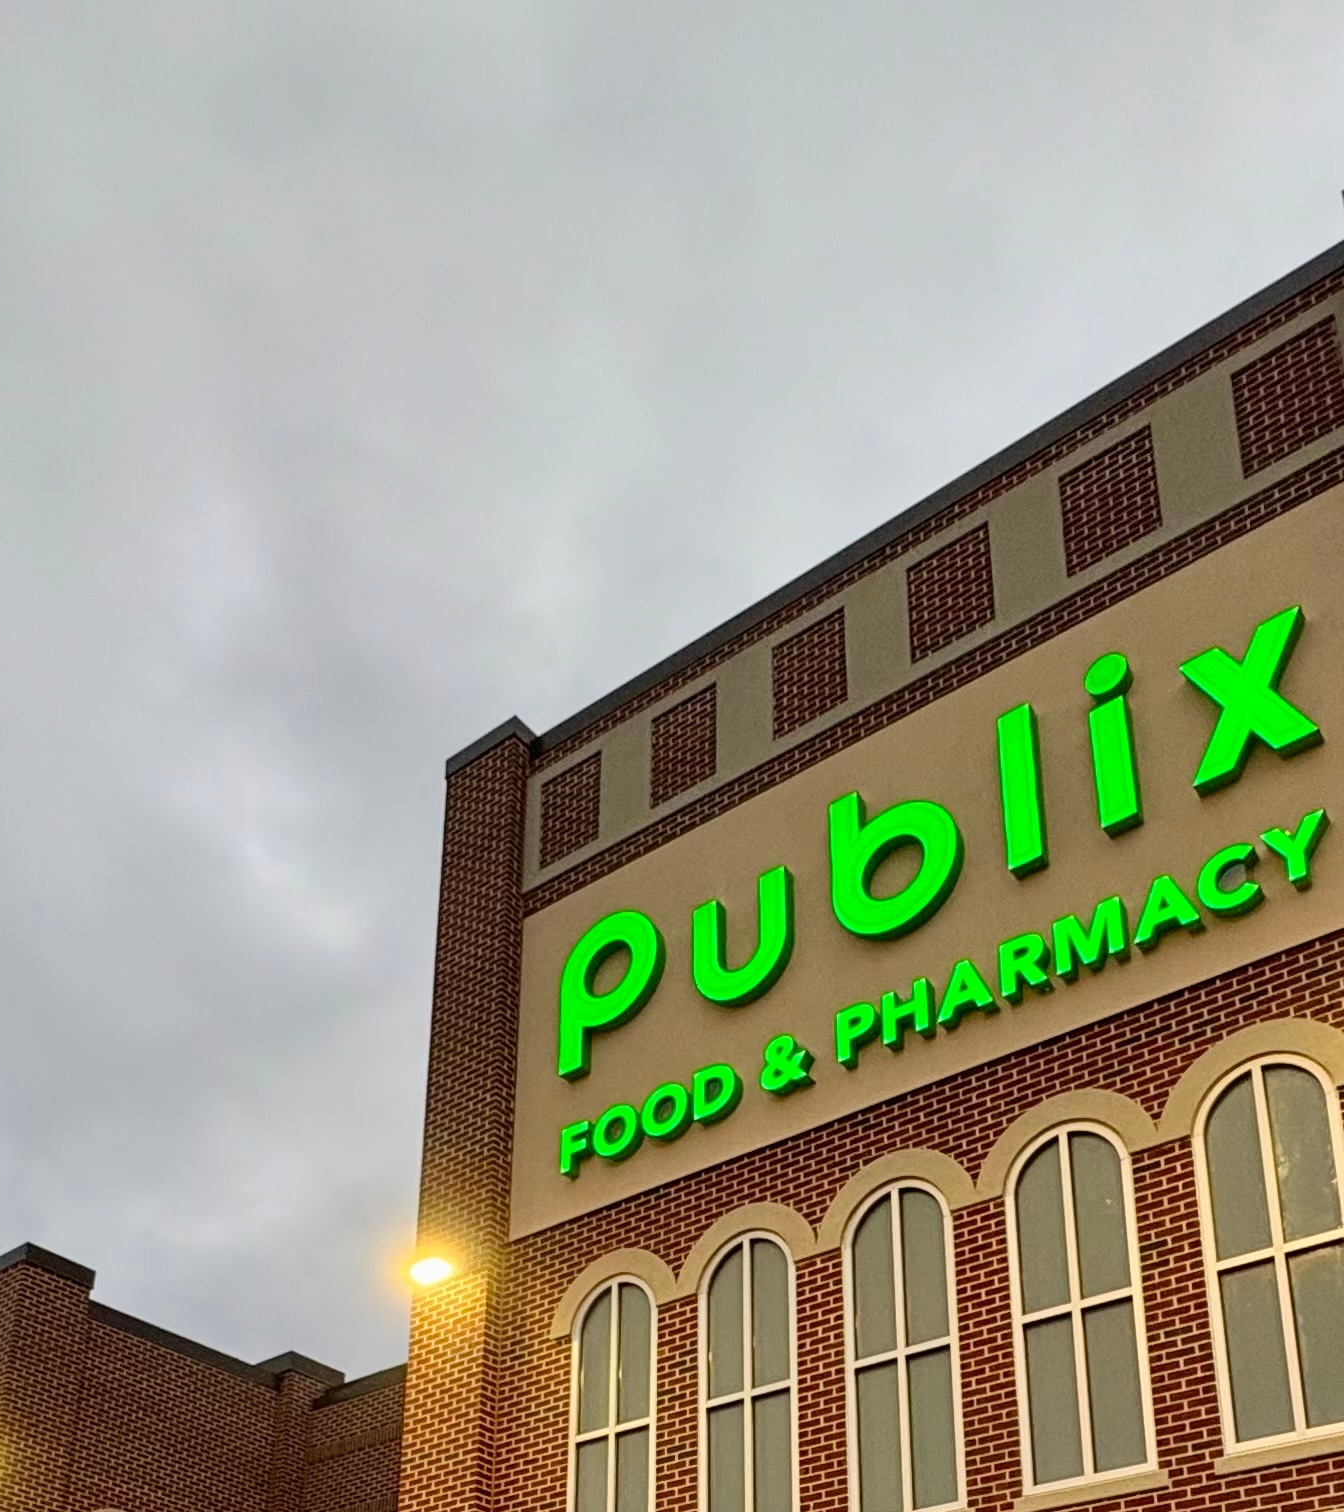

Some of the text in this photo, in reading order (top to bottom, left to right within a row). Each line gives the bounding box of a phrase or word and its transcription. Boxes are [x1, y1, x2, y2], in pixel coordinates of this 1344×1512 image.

[560, 809, 1328, 1177] FOOD & PHARMACY
